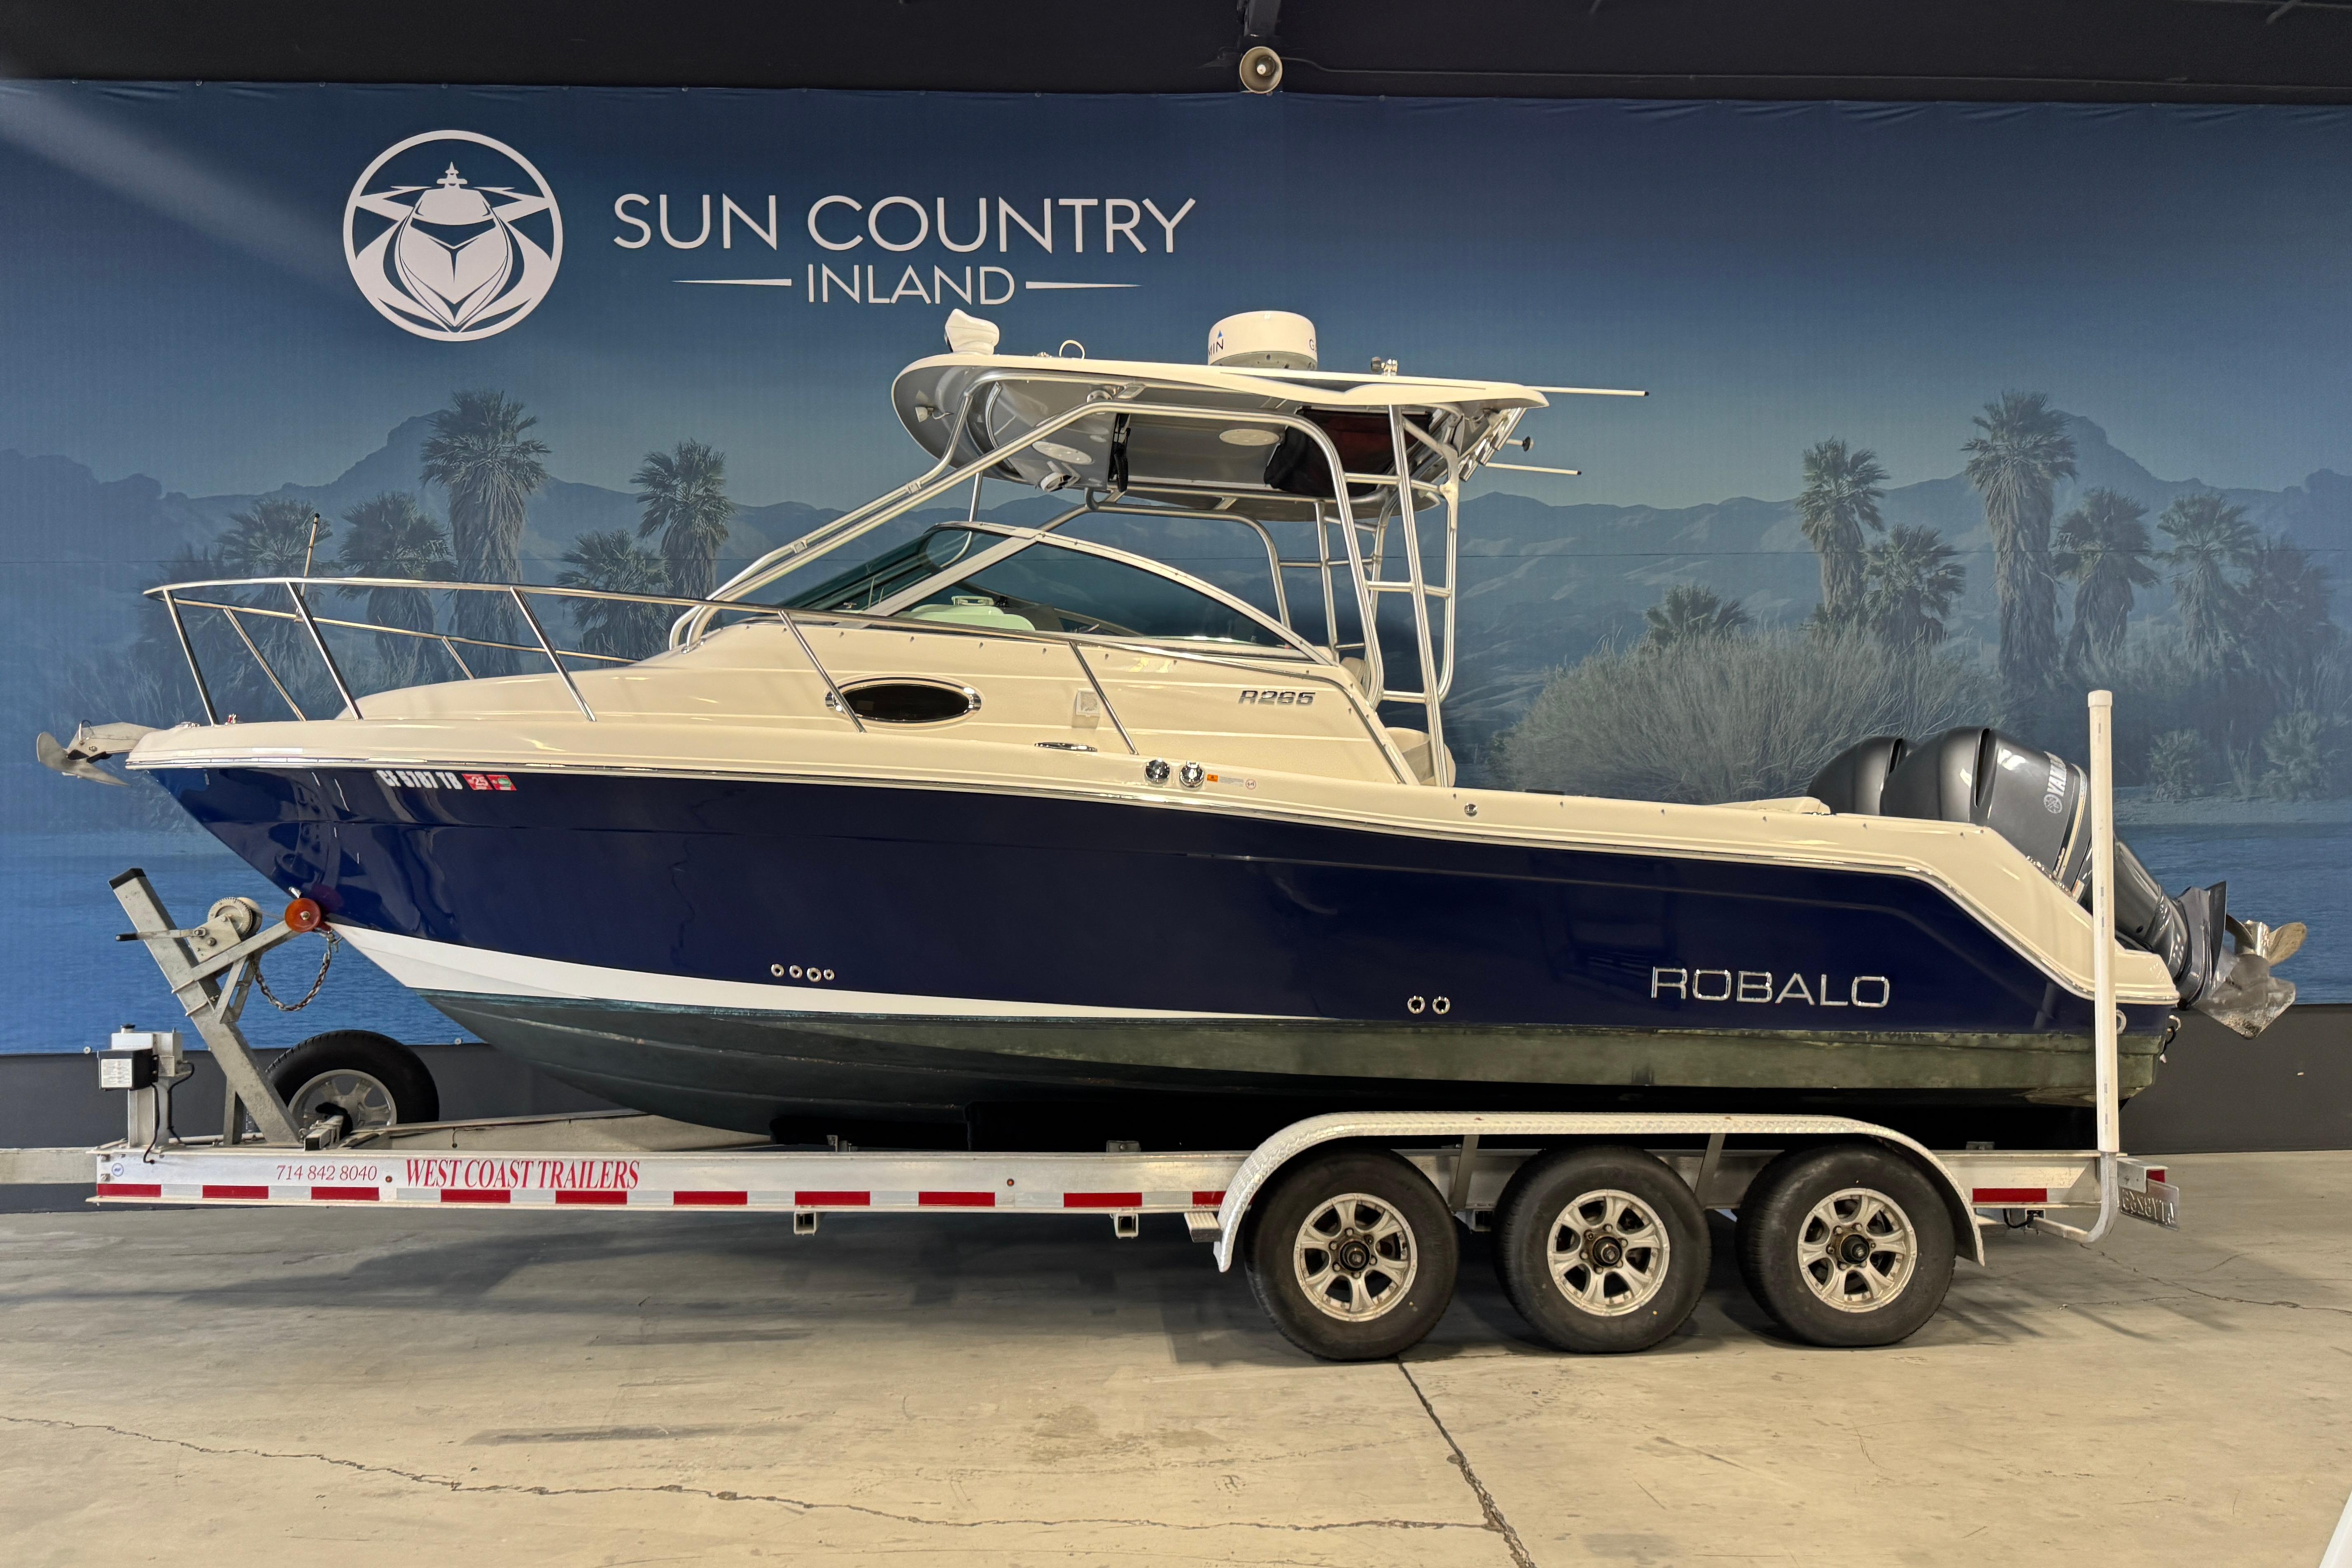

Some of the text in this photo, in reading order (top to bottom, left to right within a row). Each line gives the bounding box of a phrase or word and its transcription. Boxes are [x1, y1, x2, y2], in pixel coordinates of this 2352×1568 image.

[614, 194, 1196, 254] SUN COUNTRY
[808, 264, 1015, 306] INLAND
[1208, 338, 1224, 356] MIN
[1238, 690, 1316, 705] R265
[1651, 966, 1890, 1008] ROBALO
[277, 1165, 377, 1181] 714 842 8040
[406, 1159, 640, 1189] WEST COAST TRAILERS
